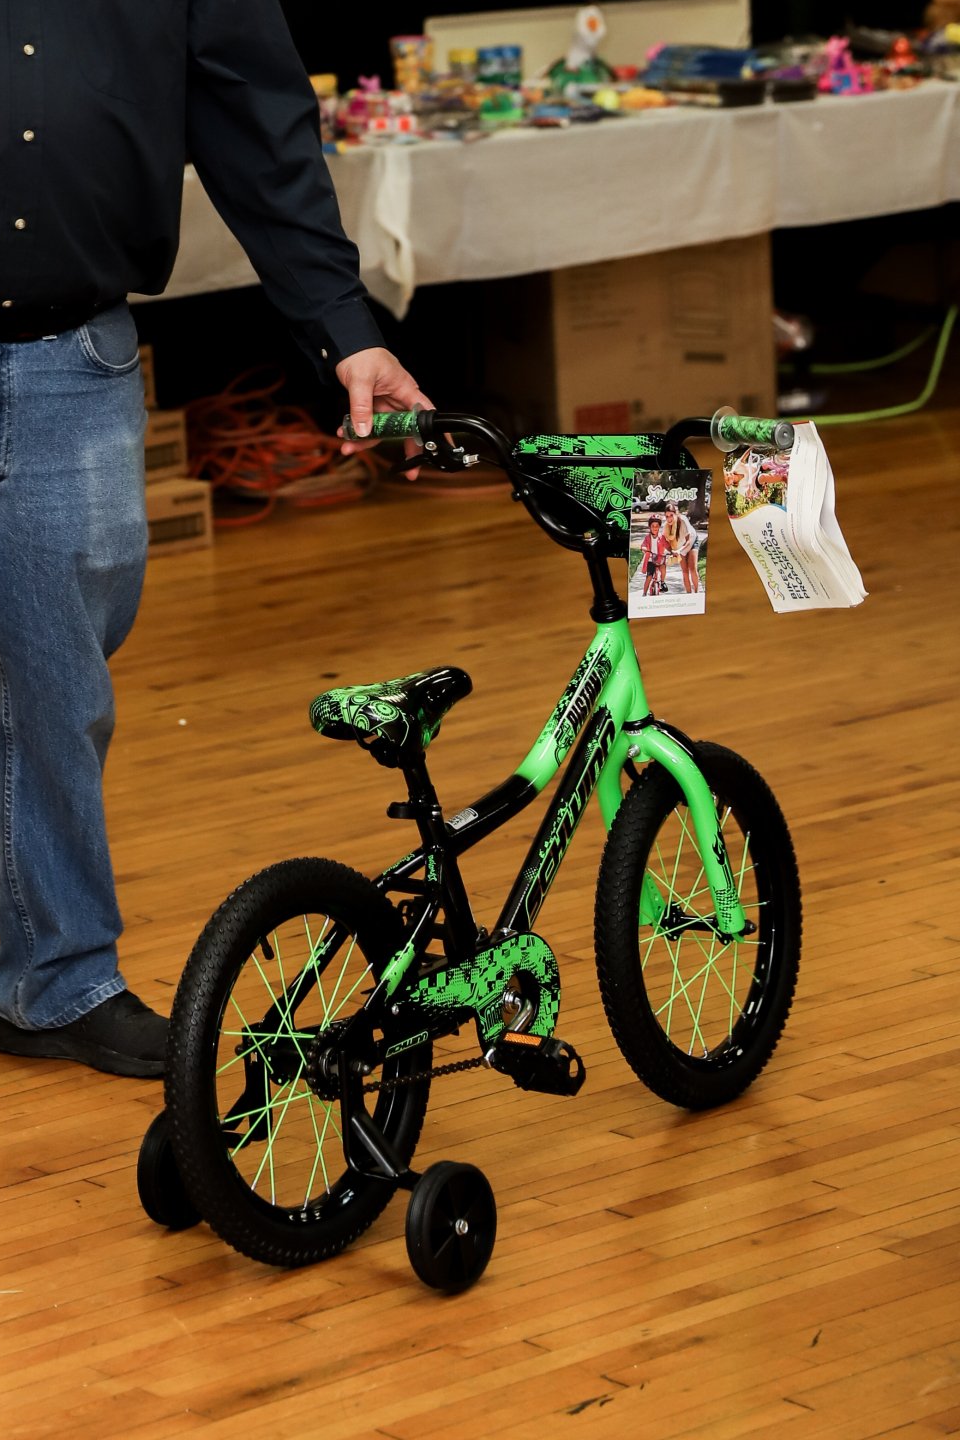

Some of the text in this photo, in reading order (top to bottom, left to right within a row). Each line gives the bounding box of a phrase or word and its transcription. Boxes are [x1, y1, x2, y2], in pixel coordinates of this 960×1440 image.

[759, 540, 798, 600] BIKES THAT
[761, 529, 805, 600] FIT A CHILD'S
[765, 521, 811, 600] PROPORTIONS
